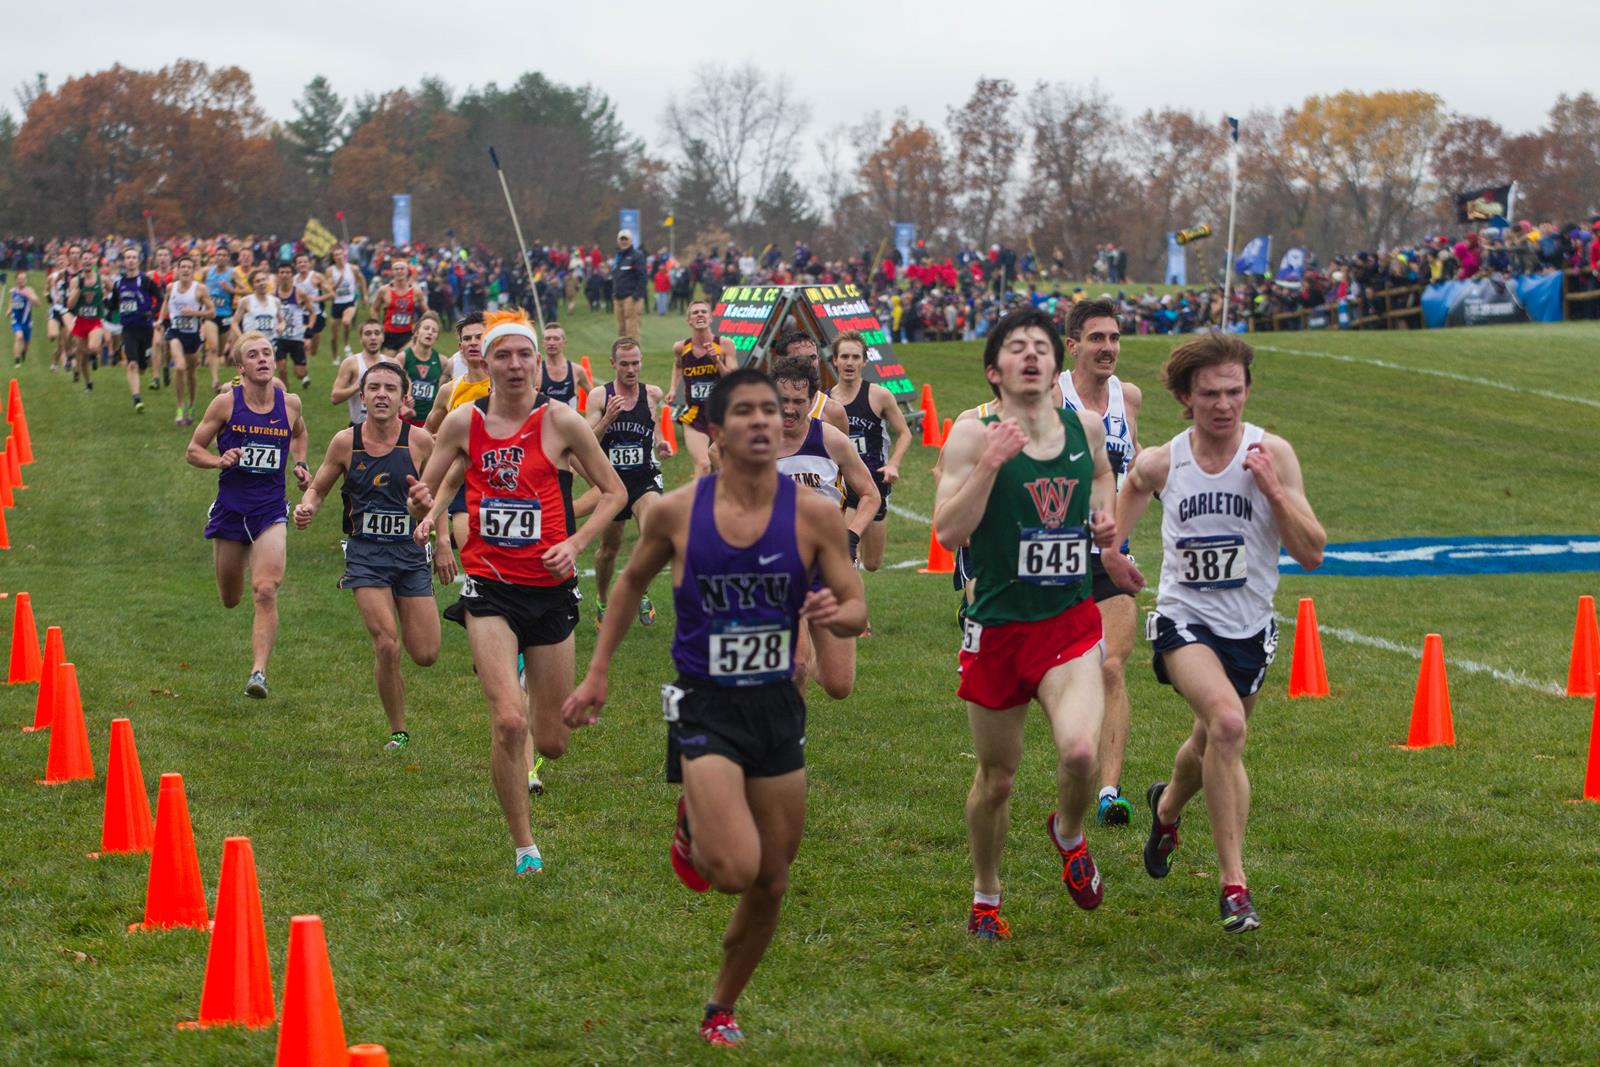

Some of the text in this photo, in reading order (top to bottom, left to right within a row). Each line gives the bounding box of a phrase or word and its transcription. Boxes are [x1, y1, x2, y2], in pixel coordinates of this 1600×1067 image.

[231, 423, 289, 438] CAL LUTHERAN
[243, 447, 277, 468] 374
[481, 446, 525, 471] RIT
[612, 448, 640, 465] 363
[1178, 491, 1253, 522] CARLETON
[367, 514, 405, 535] 405
[485, 509, 535, 538] 579
[1026, 541, 1080, 575] 645
[1182, 548, 1239, 581] 387
[698, 573, 791, 614] NYU
[720, 633, 782, 673] 528
